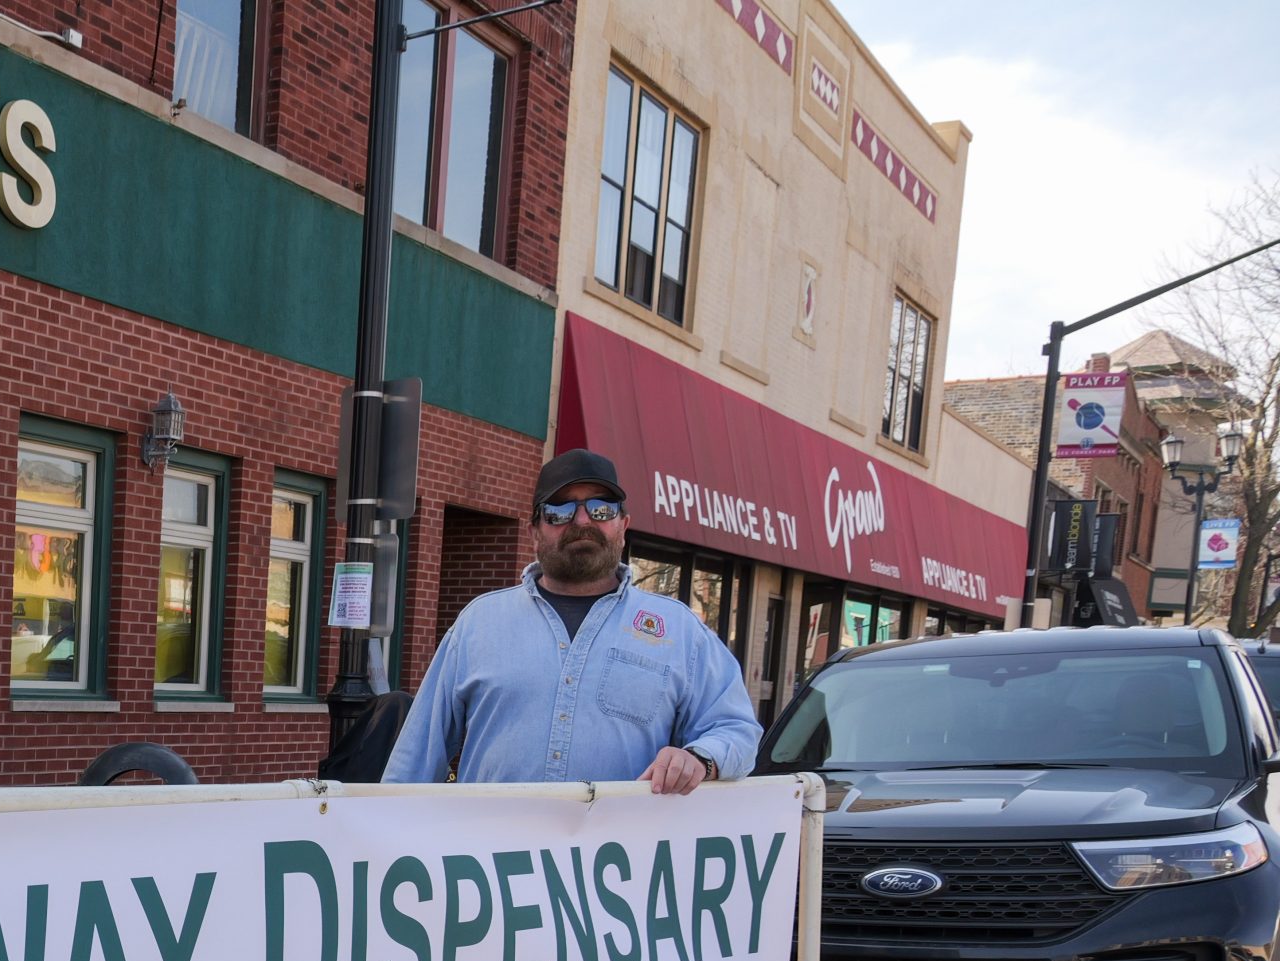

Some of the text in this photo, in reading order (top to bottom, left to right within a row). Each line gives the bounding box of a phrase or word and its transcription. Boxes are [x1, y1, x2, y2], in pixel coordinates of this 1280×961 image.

[1069, 375, 1120, 387] PLAY FP
[655, 471, 797, 550] APPLIANCE & TV
[824, 460, 884, 574] Grand
[921, 556, 969, 597] APPLIANCE
[968, 572, 977, 599] &
[975, 574, 987, 602] TV
[879, 873, 922, 891] Ford
